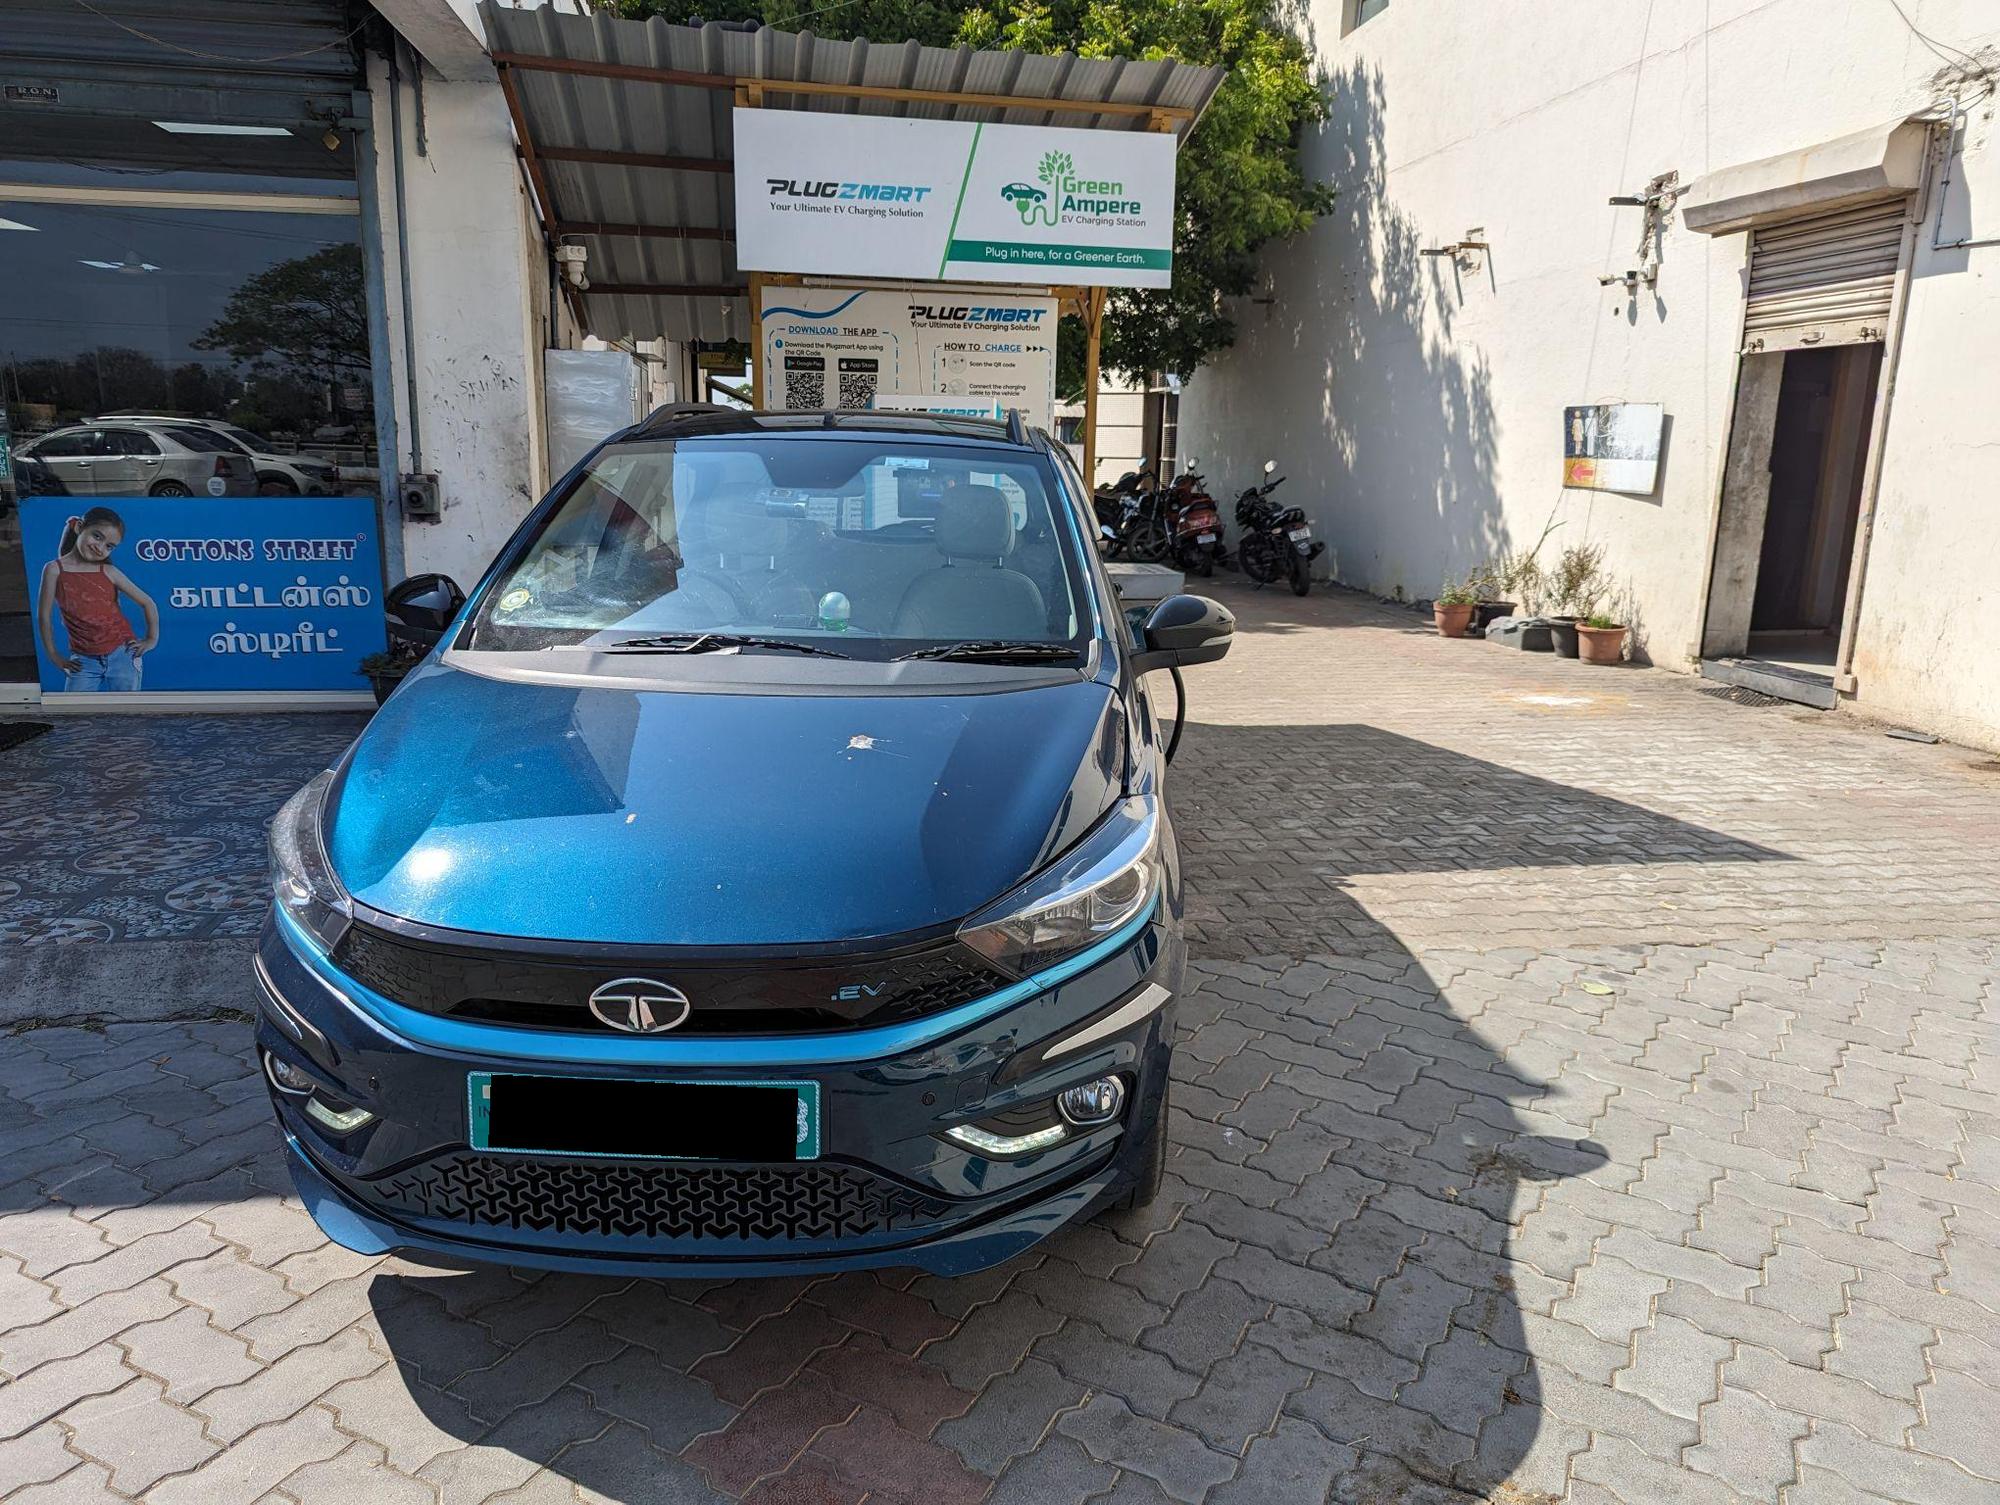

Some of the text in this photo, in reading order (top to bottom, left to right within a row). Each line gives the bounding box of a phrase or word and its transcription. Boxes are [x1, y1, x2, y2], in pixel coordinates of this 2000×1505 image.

[1063, 176, 1123, 195] Green
[770, 202, 924, 219] Your Ultimate EV Charging Solution
[1062, 194, 1141, 216] Ampere
[1062, 215, 1146, 228] EV Charging Station
[985, 246, 1146, 264] Plug in here, for a Greener Earth.
[788, 326, 877, 336] DOWNLOAD THE APP
[911, 320, 1041, 332] Your Ultimate EV Charging Solution
[785, 341, 815, 349] Download
[944, 342, 1021, 353] HOW TO CHARGE
[942, 357, 946, 367] 1
[940, 383, 947, 393] 2
[136, 539, 357, 562] COTTONS STREET
[170, 575, 371, 608] காட்டன்ஸ்
